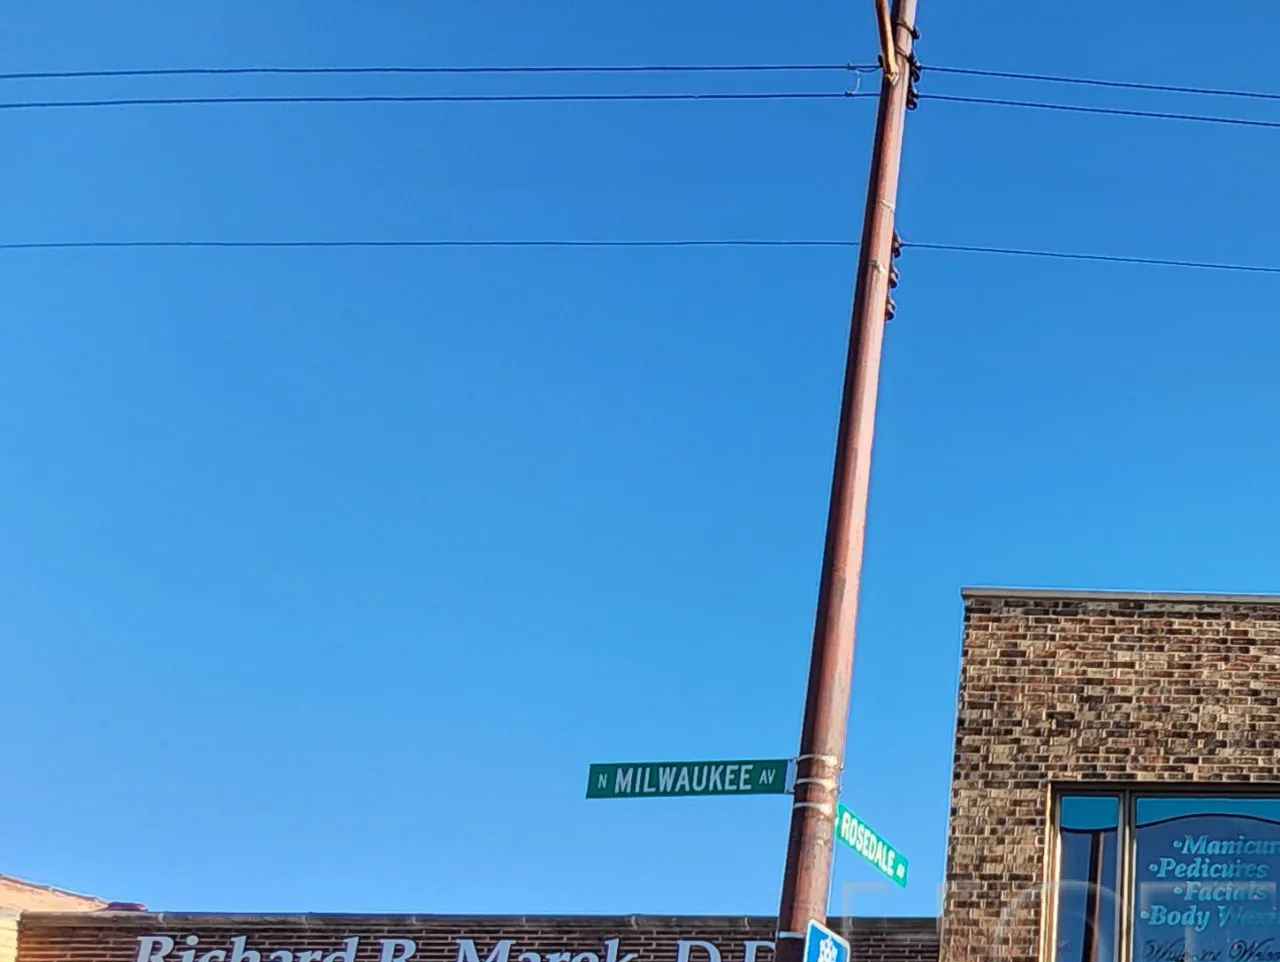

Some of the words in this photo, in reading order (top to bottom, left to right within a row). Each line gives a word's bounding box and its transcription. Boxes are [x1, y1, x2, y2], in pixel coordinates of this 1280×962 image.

[597, 773, 608, 789] N
[614, 764, 755, 795] MILWAUKEE
[759, 769, 777, 785] AV
[840, 811, 895, 876] ROSEDALE
[1148, 905, 1211, 933] Body
